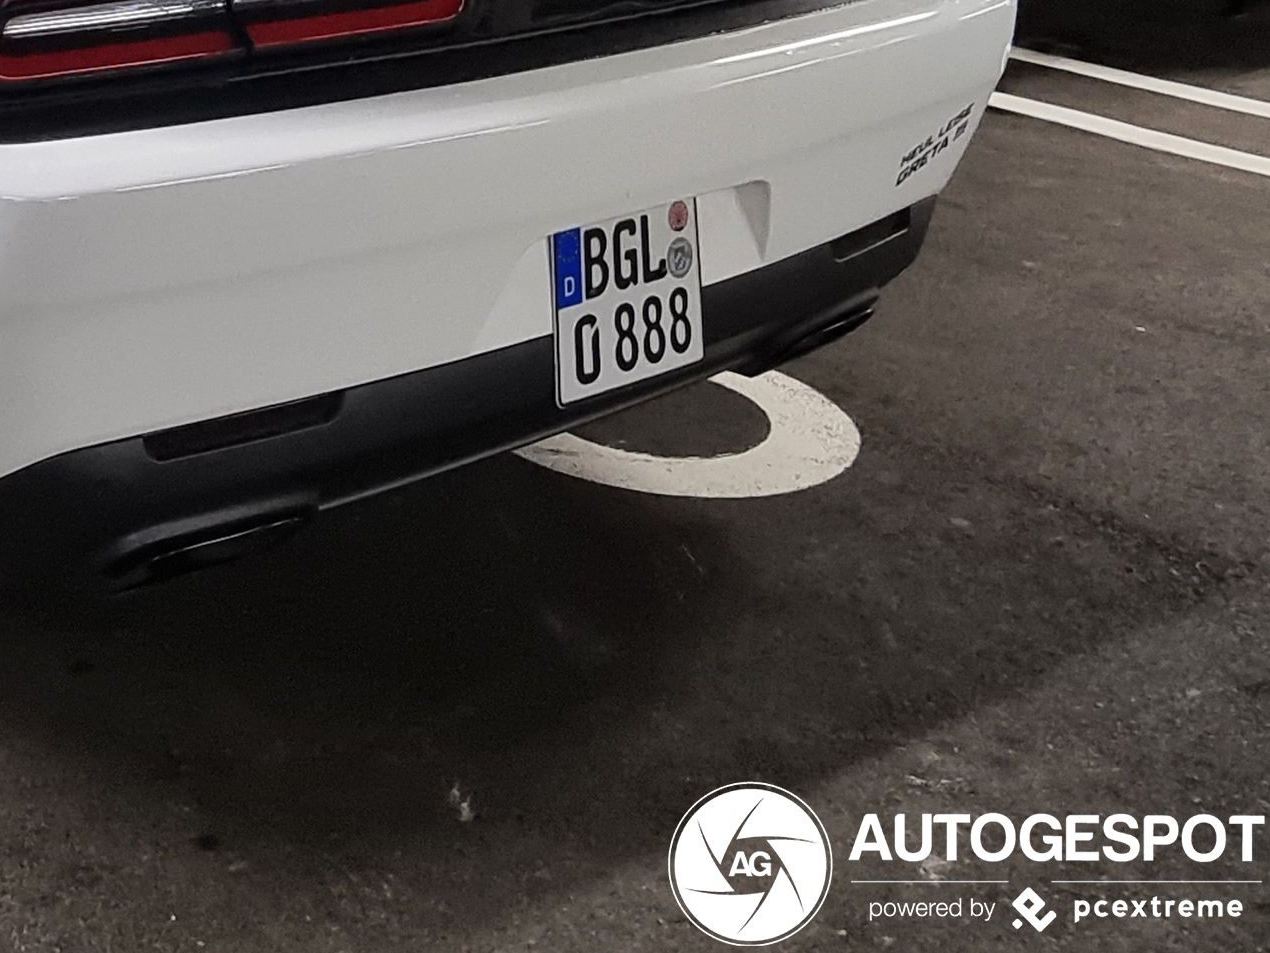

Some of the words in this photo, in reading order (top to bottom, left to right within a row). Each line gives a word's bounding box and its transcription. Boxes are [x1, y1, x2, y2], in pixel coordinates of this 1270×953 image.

[895, 135, 949, 187] GRETA
[564, 276, 575, 298] D
[584, 215, 668, 300] BGL
[614, 287, 692, 372] 888
